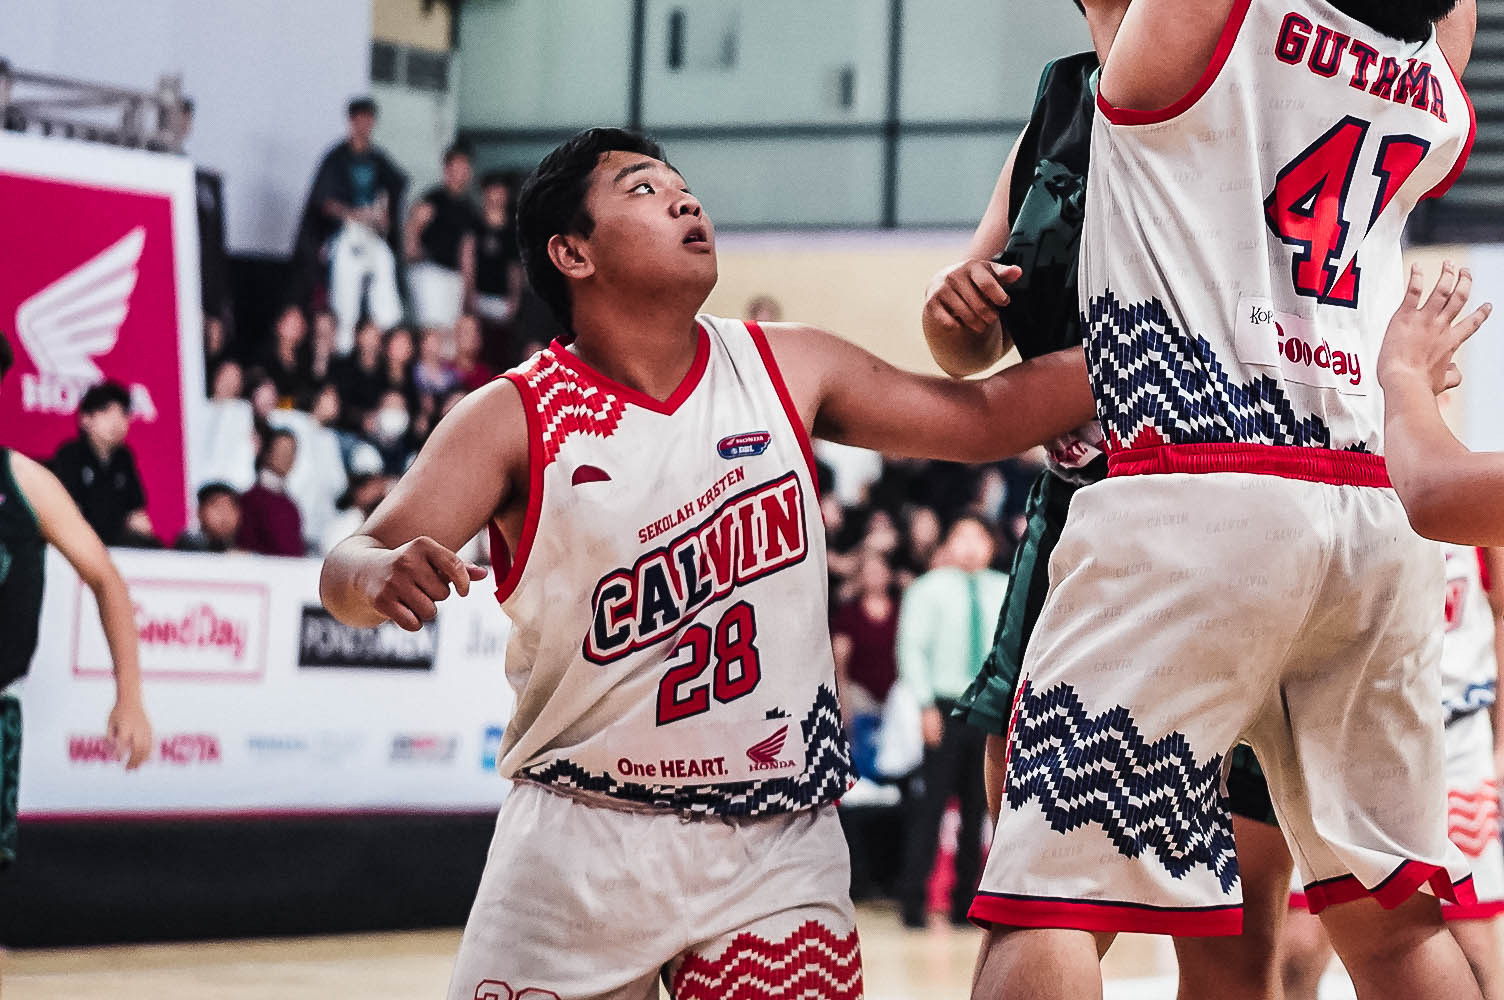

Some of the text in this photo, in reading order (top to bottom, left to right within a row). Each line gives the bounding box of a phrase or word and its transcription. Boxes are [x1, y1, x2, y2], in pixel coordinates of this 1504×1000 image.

[1263, 115, 1431, 309] 41
[1250, 306, 1275, 325] KOP
[638, 502, 696, 545] SEKOLAH
[585, 473, 806, 664] CALVIN
[656, 600, 761, 727] 28
[617, 757, 729, 778] One HEART.
[749, 759, 797, 773] HONDA
